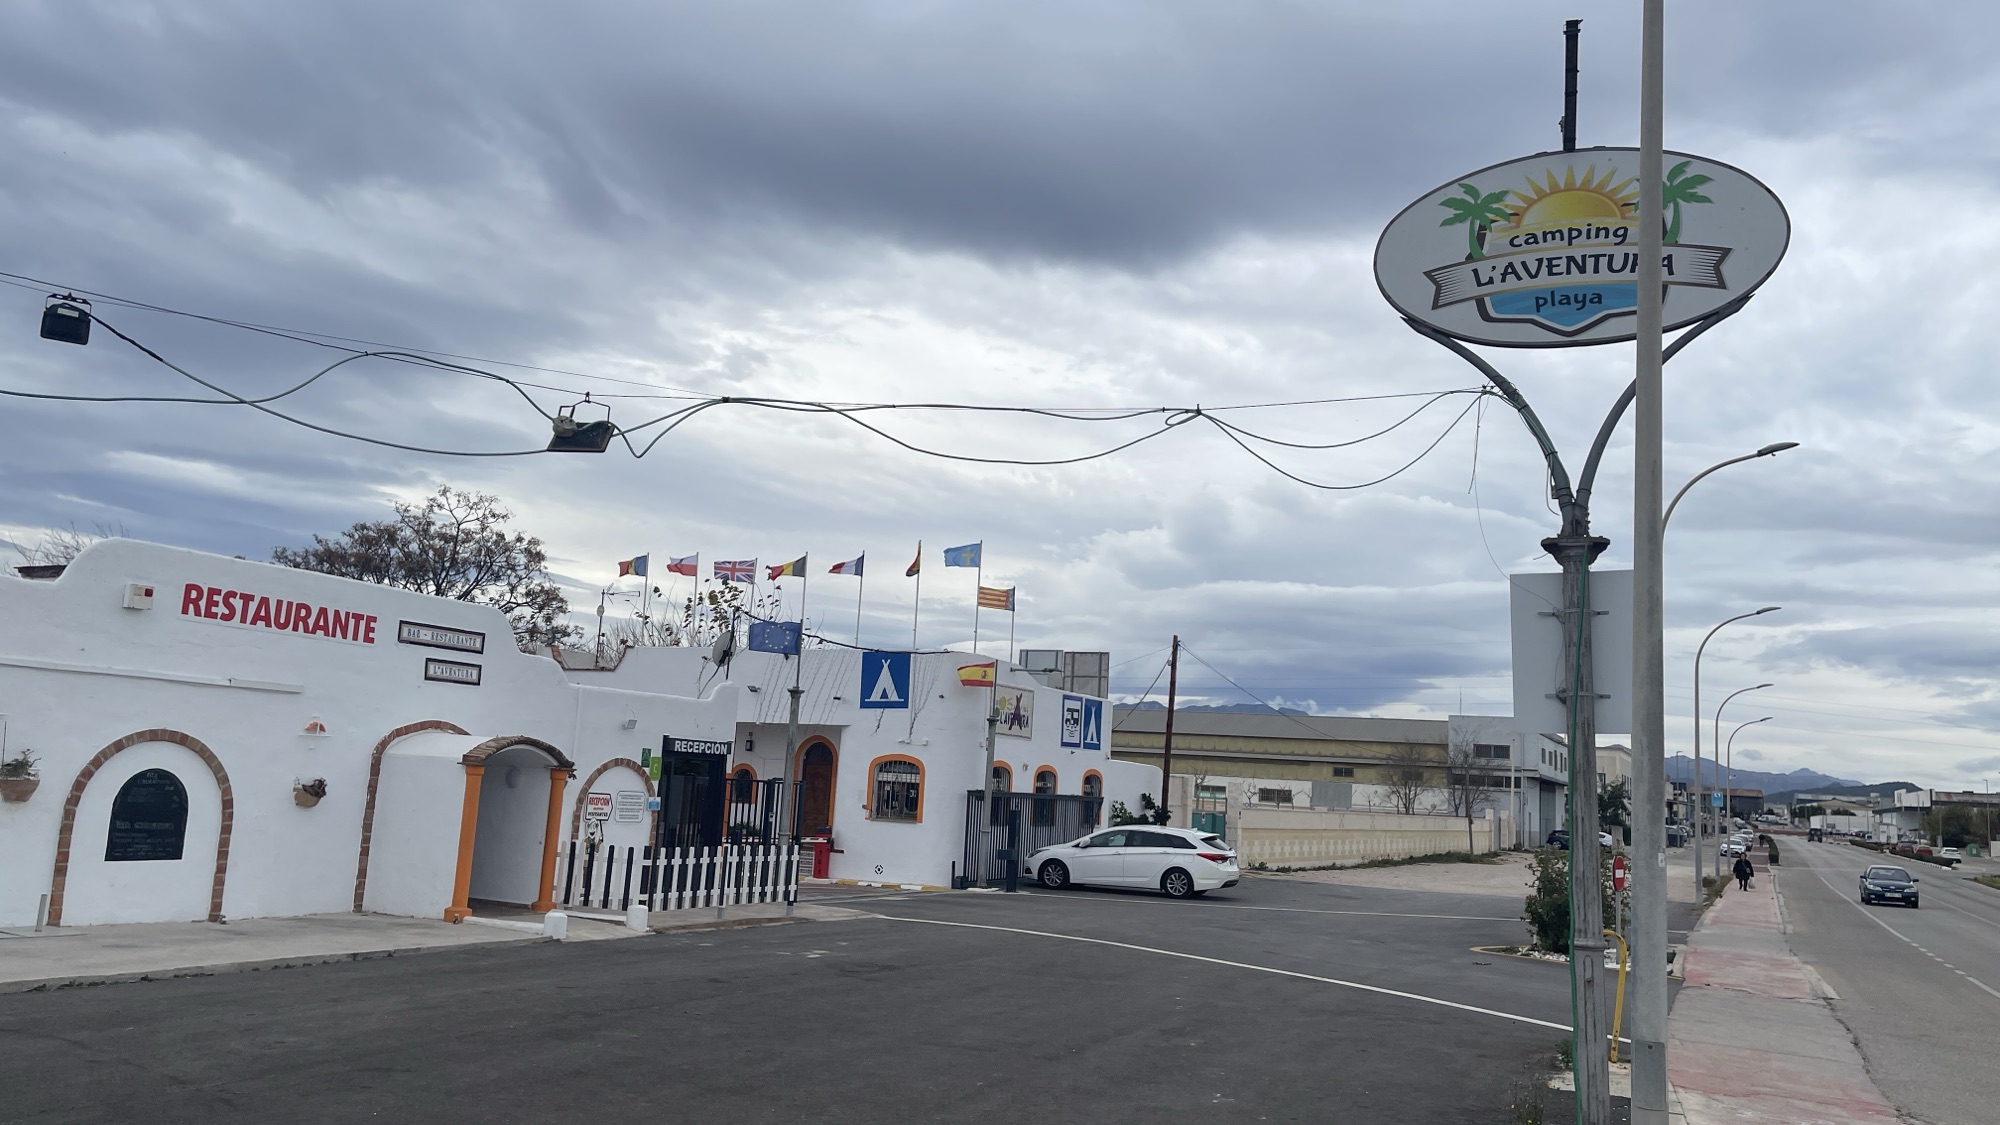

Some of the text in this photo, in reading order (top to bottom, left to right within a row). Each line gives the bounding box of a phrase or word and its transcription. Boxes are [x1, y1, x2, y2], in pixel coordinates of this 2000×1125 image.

[1509, 223, 1629, 248] camping
[1535, 290, 1603, 312] playa
[181, 583, 378, 644] RESTAURANTE
